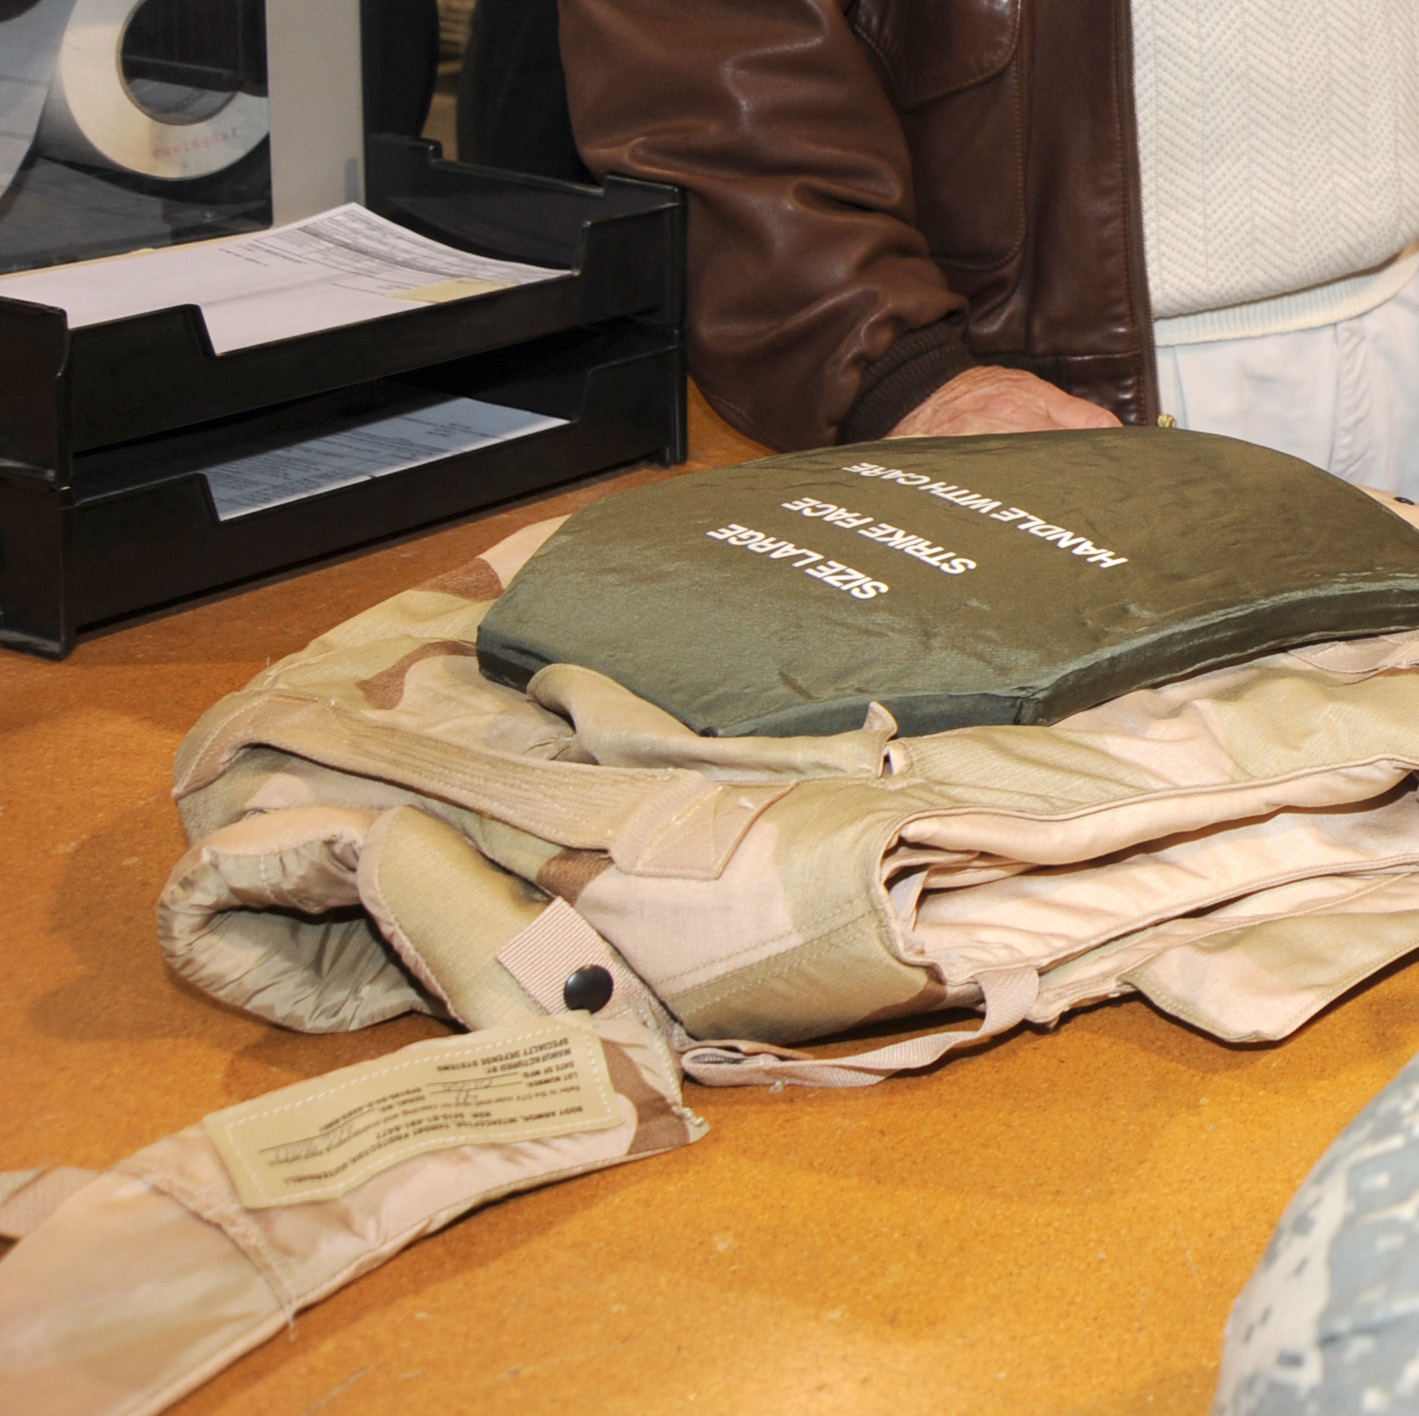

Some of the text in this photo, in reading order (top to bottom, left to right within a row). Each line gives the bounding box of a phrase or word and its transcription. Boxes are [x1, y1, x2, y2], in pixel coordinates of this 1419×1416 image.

[782, 496, 977, 576] STRIKE FACE
[842, 461, 1129, 569] HANDLE WITH CARE
[706, 522, 889, 600] SIZE LARGE
[522, 1037, 569, 1056] SPECIALTY
